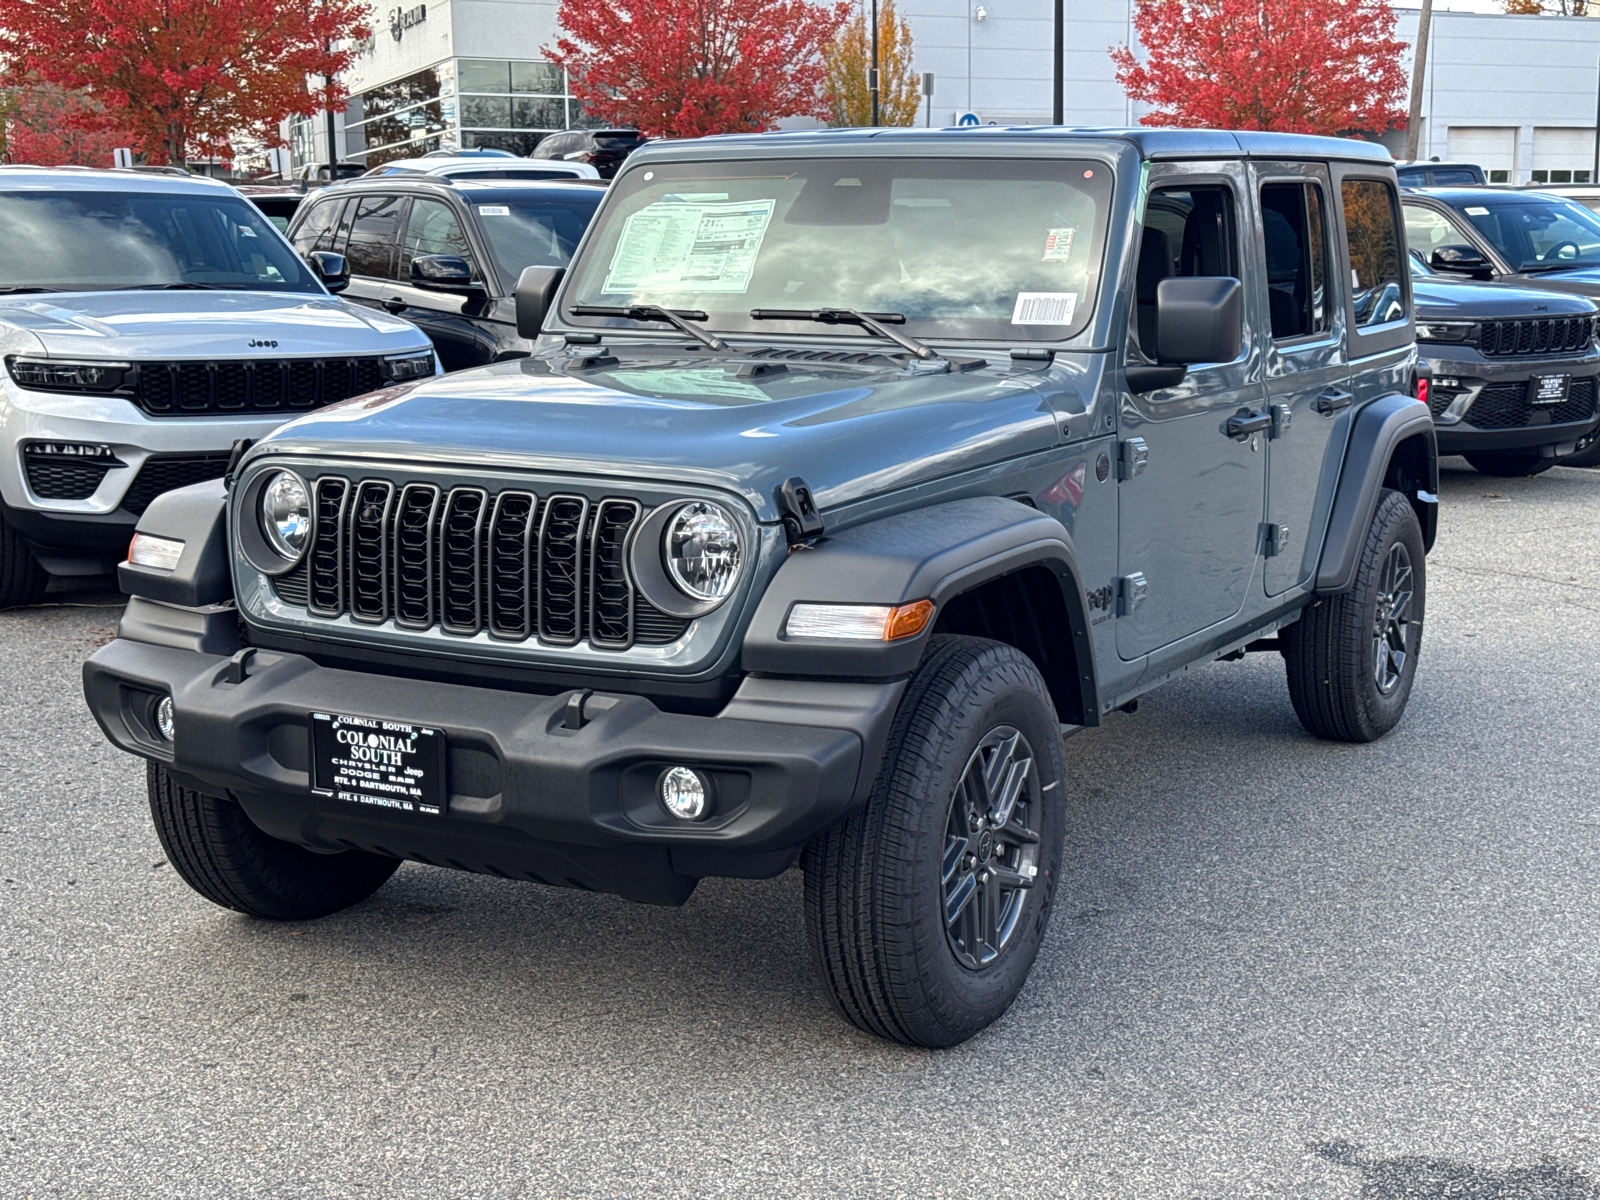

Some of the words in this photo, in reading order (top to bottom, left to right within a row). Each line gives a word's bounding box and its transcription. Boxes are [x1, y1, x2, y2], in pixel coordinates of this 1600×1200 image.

[400, 4, 426, 28] RAM
[247, 338, 279, 350] Jeep
[337, 716, 378, 728] COLONIAL
[382, 722, 412, 733] SOUTH
[421, 728, 434, 736] Jeep
[336, 729, 417, 754] COLONIAL
[350, 745, 402, 766] SOUTH
[331, 757, 396, 773] CHRYSLER
[404, 766, 424, 778] Jeep
[340, 767, 381, 780] DODGE
[388, 775, 415, 785] RAM
[334, 775, 350, 786] RTE.
[360, 780, 409, 795] DARTMOUTH,
[410, 786, 422, 796] MA
[338, 792, 353, 802] RTE.
[360, 796, 402, 810] DARTMOUTH,
[403, 802, 414, 811] MA
[419, 806, 440, 815] RAM
